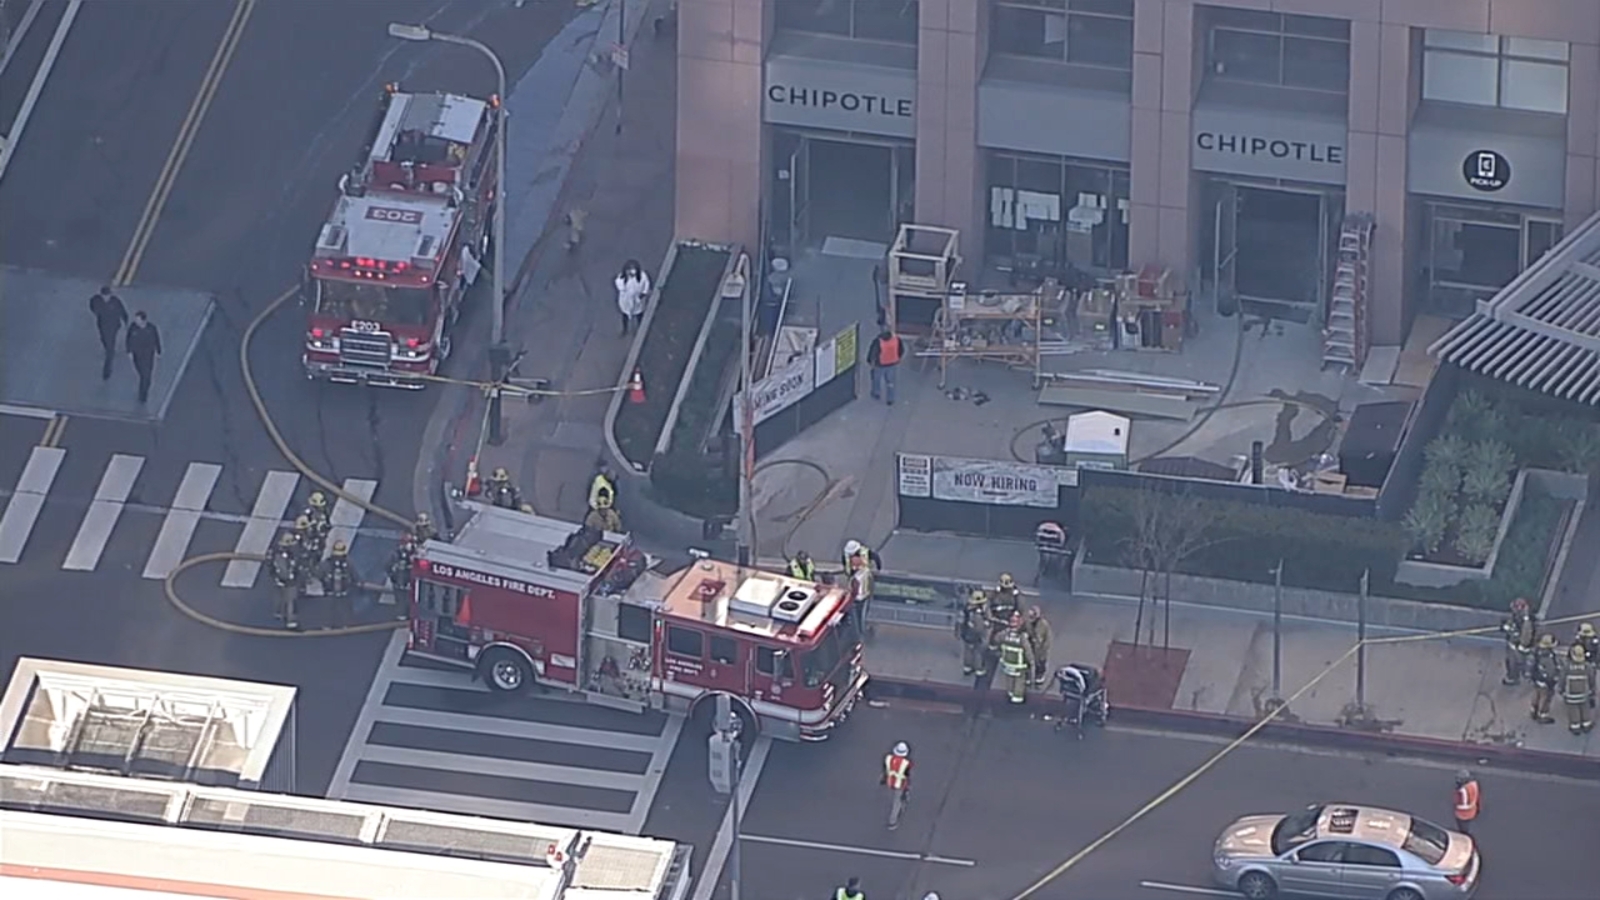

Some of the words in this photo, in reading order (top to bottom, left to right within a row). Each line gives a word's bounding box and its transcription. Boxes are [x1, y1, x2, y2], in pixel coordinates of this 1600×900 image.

[768, 84, 913, 117] CHIPOTLE
[1197, 132, 1343, 164] CHIPOTLE
[373, 209, 417, 221] 203
[954, 473, 986, 488] NOW
[991, 476, 1037, 491] HIRING
[432, 563, 453, 576] LOS
[455, 569, 501, 587] ANGELES
[503, 579, 526, 593] FIRE
[527, 585, 556, 599] DEPT.
